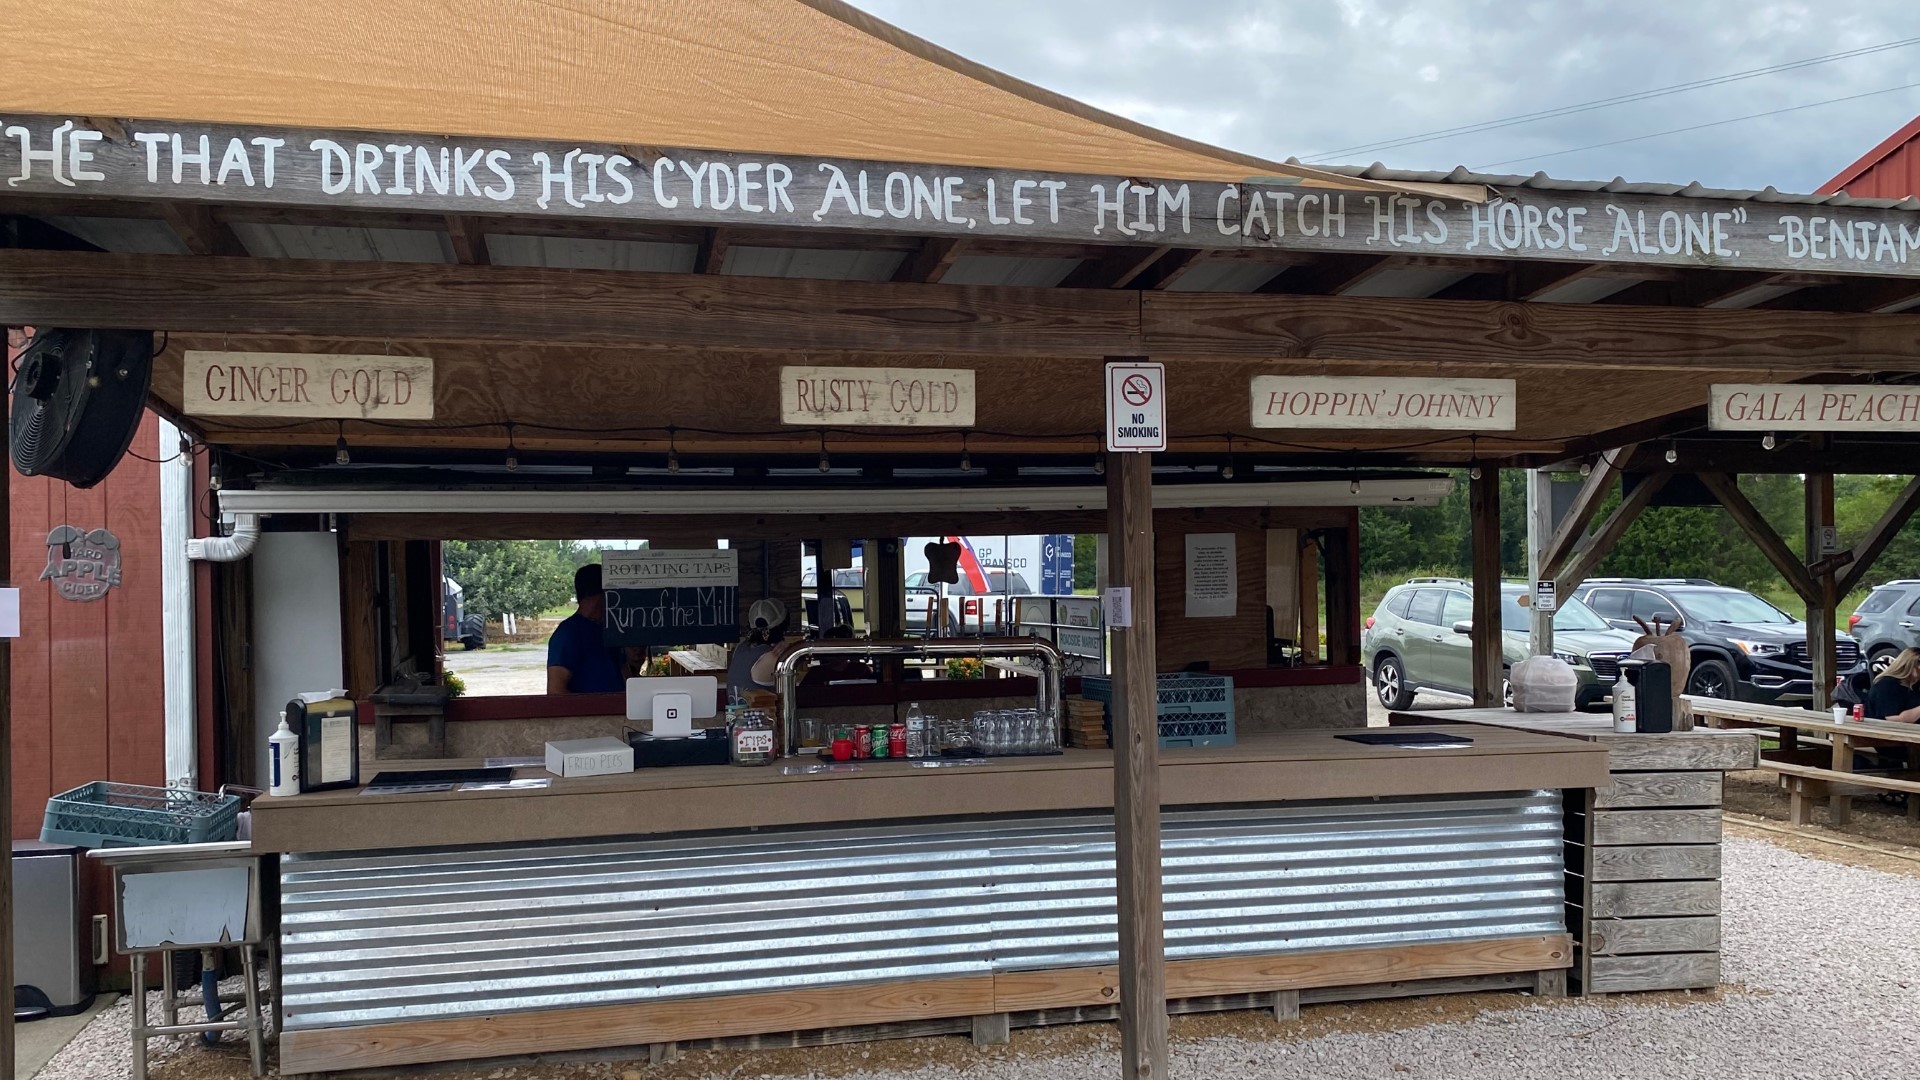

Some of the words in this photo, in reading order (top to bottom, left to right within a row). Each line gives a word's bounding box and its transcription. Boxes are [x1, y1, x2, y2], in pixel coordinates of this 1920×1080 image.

[0, 119, 105, 187] HE
[134, 131, 285, 188] THAT
[310, 138, 515, 201] DRINKS
[534, 147, 634, 210] HIS
[653, 156, 794, 214] CYDER
[812, 163, 976, 230] ALONE,
[988, 177, 1067, 226] LET
[1093, 179, 1191, 236] HIM
[1217, 185, 1345, 238] CATCH
[1365, 190, 1447, 247] HIS
[1463, 195, 1587, 252] HORSE
[205, 364, 312, 403] GINGER
[331, 368, 412, 406] GOLD
[796, 379, 873, 412] RUSTY
[889, 379, 958, 413] GOLD
[1387, 393, 1503, 418] JOHNNY
[1725, 392, 1809, 421] GALA
[1817, 393, 1920, 422] PEACH
[1131, 413, 1145, 424] NO
[1118, 427, 1159, 438] SMOKING
[978, 548, 992, 558] GP
[39, 560, 121, 589] APPLE
[609, 562, 690, 576] ROTATING
[692, 562, 731, 575] TAPS
[63, 582, 100, 595] CIDER
[604, 590, 653, 633] Run
[651, 590, 669, 627] of
[670, 587, 694, 626] the
[697, 586, 735, 627] Mill
[742, 734, 767, 747] TIPS
[568, 756, 596, 772] FRIED
[600, 753, 623, 769] PIES
